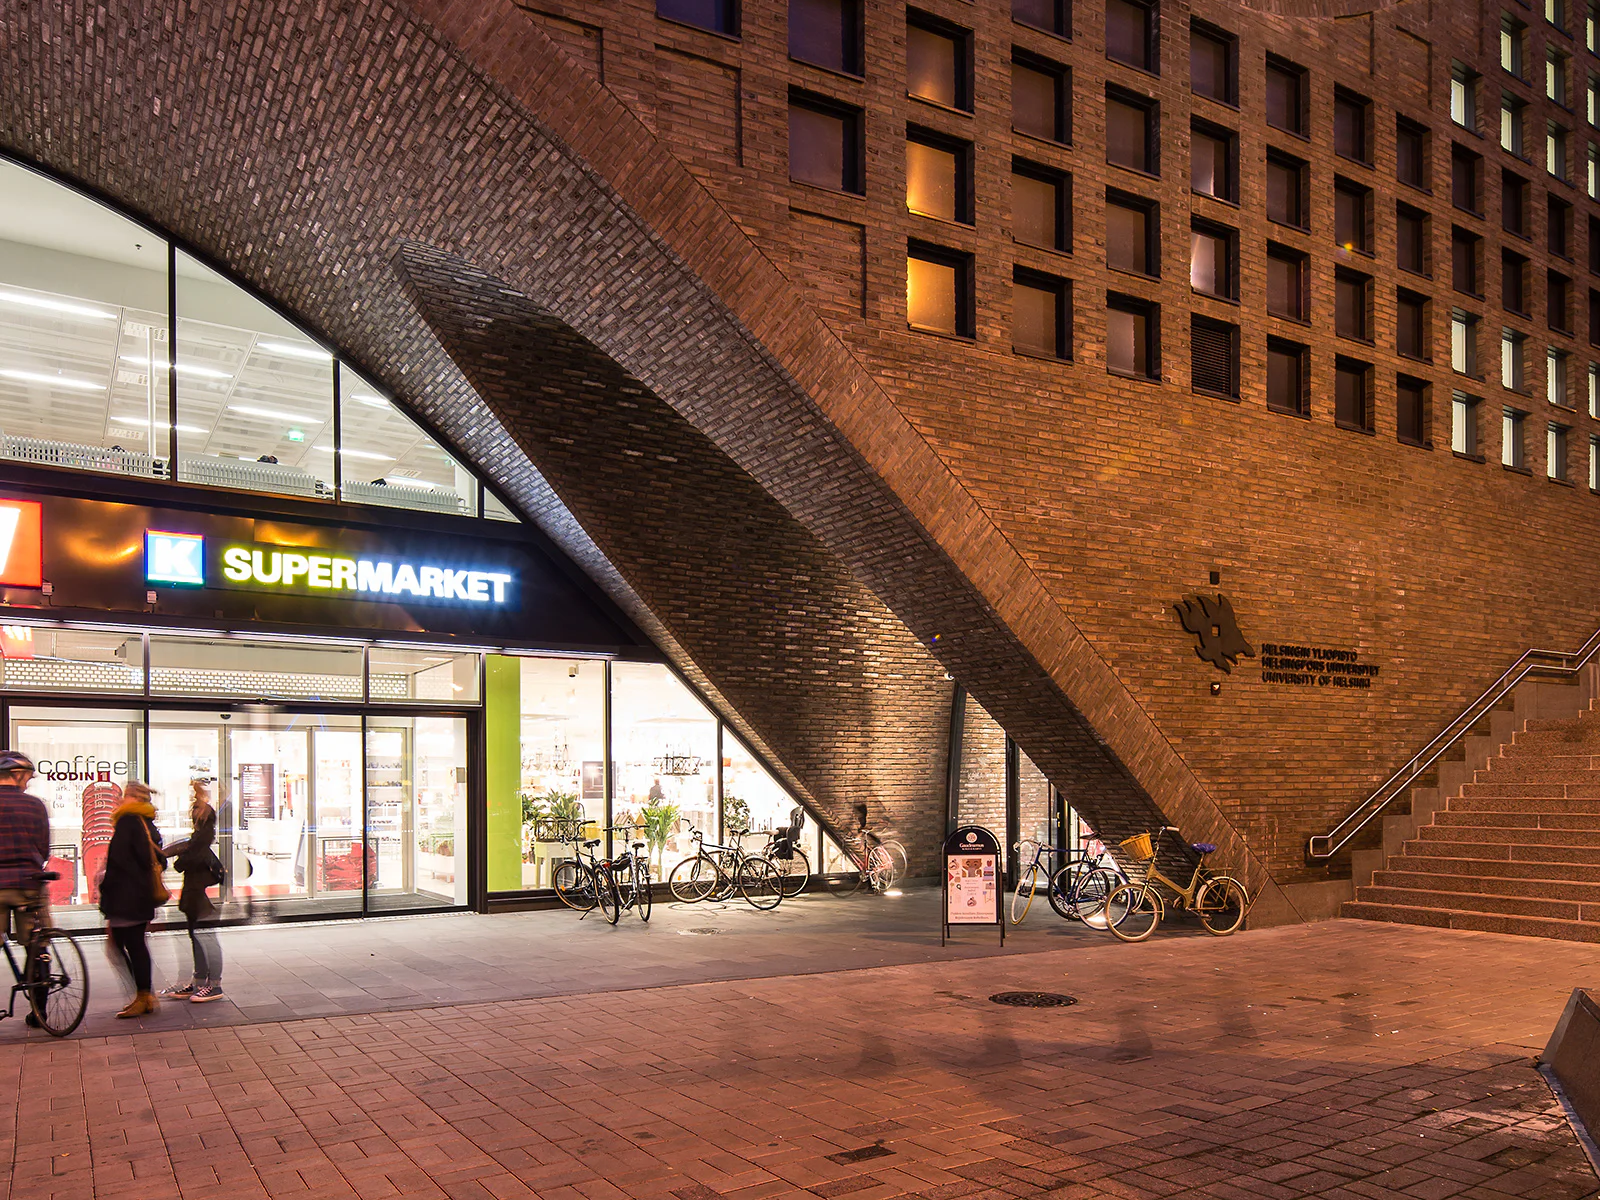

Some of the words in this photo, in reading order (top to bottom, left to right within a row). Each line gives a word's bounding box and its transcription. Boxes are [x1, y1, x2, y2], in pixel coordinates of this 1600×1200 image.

[154, 537, 199, 577] K
[222, 547, 512, 603] SUPERMARKET
[1261, 643, 1311, 659] HELSINGIN
[1312, 648, 1358, 663] YLIOPISTO
[1262, 657, 1324, 673] HELSINGFORS
[1261, 671, 1316, 686] UNIVERSITY
[1318, 675, 1332, 686] OF
[1333, 677, 1371, 689] HELSINKI
[38, 756, 128, 774] coffee
[47, 772, 94, 781] KODIN
